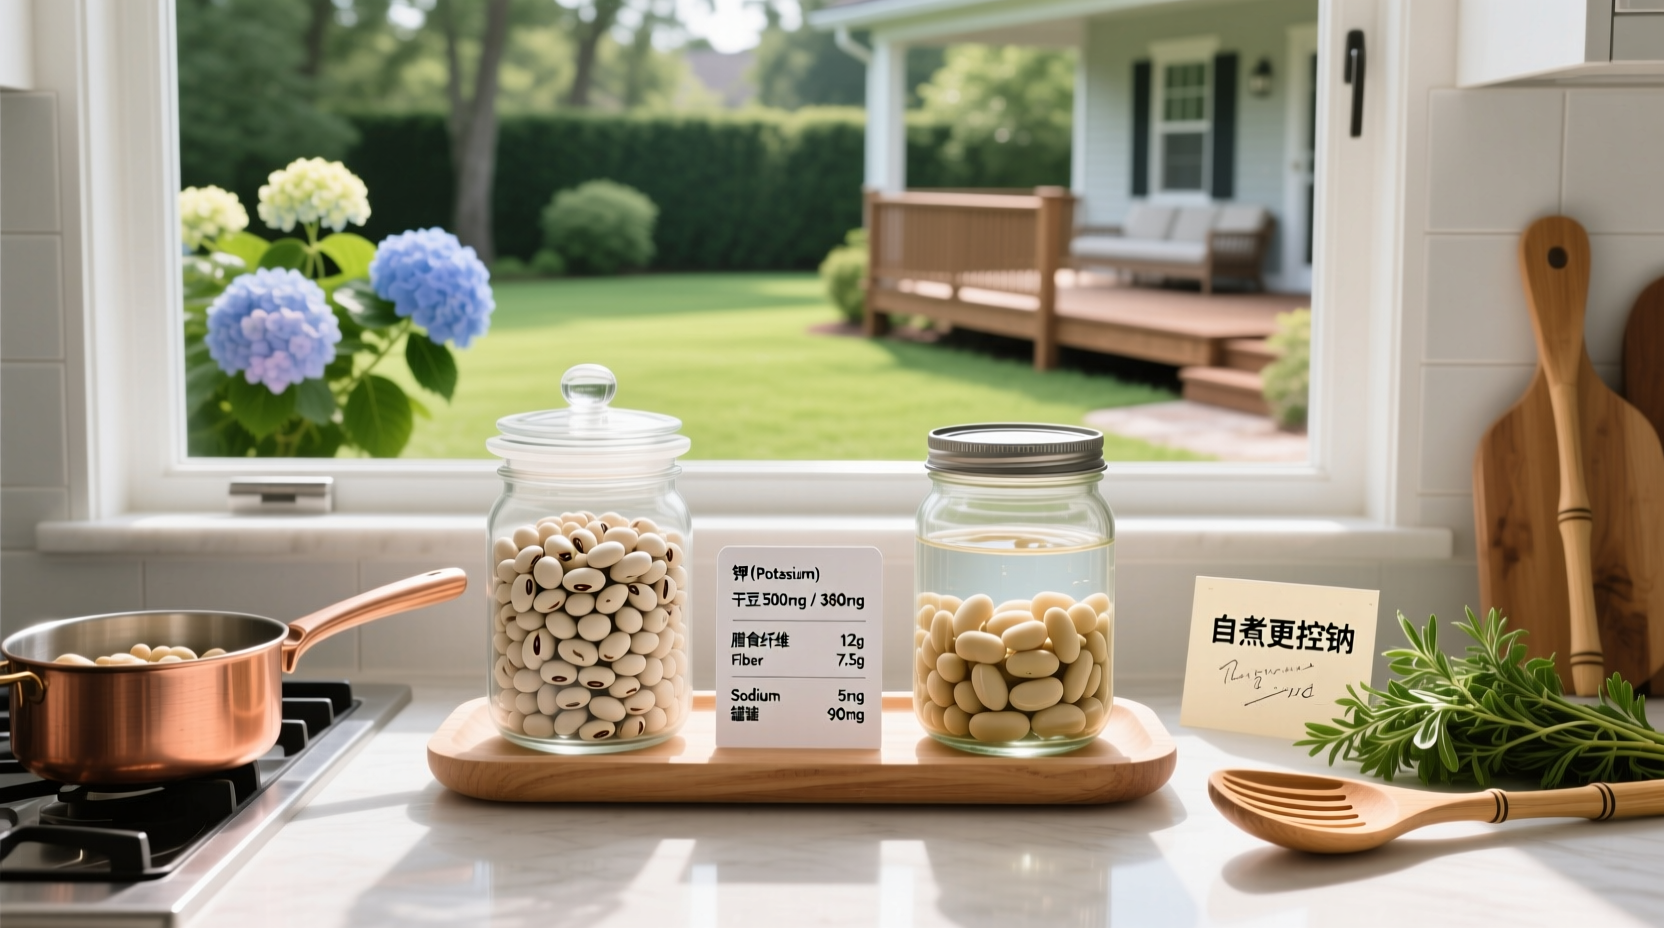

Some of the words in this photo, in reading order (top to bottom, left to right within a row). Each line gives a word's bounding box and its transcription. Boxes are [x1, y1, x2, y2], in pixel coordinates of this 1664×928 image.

[840, 633, 865, 650] 12g
[1212, 614, 1355, 655] 自煮更控钠
[836, 653, 865, 670] 7.5g
[731, 688, 781, 702] Sodium
[827, 707, 865, 724] 90mg
